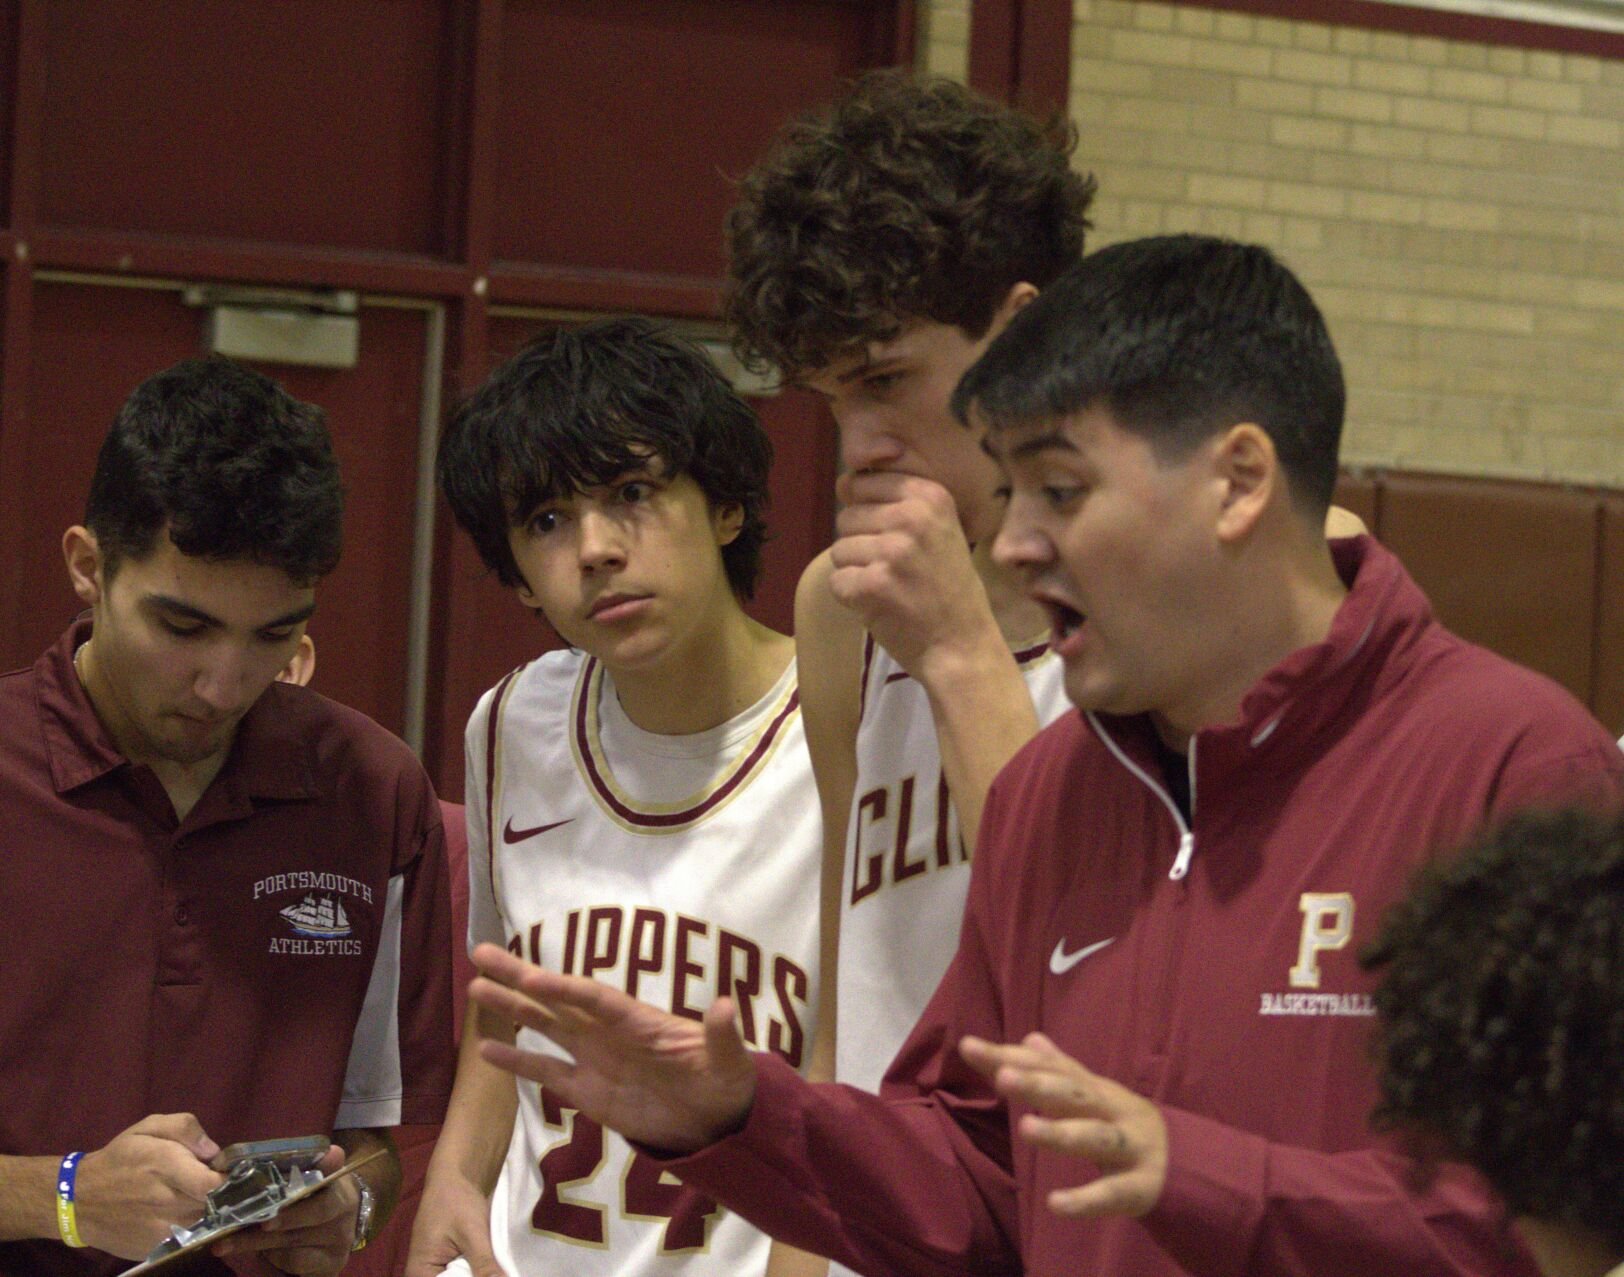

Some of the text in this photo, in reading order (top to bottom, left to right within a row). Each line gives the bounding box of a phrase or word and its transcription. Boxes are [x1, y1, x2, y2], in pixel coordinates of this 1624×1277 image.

[850, 768, 969, 908] CLI
[253, 871, 373, 905] PORTSMOUTH
[269, 938, 362, 956] ATHLETICS
[1289, 892, 1355, 989] P
[1258, 993, 1377, 1017] BASKETBALL
